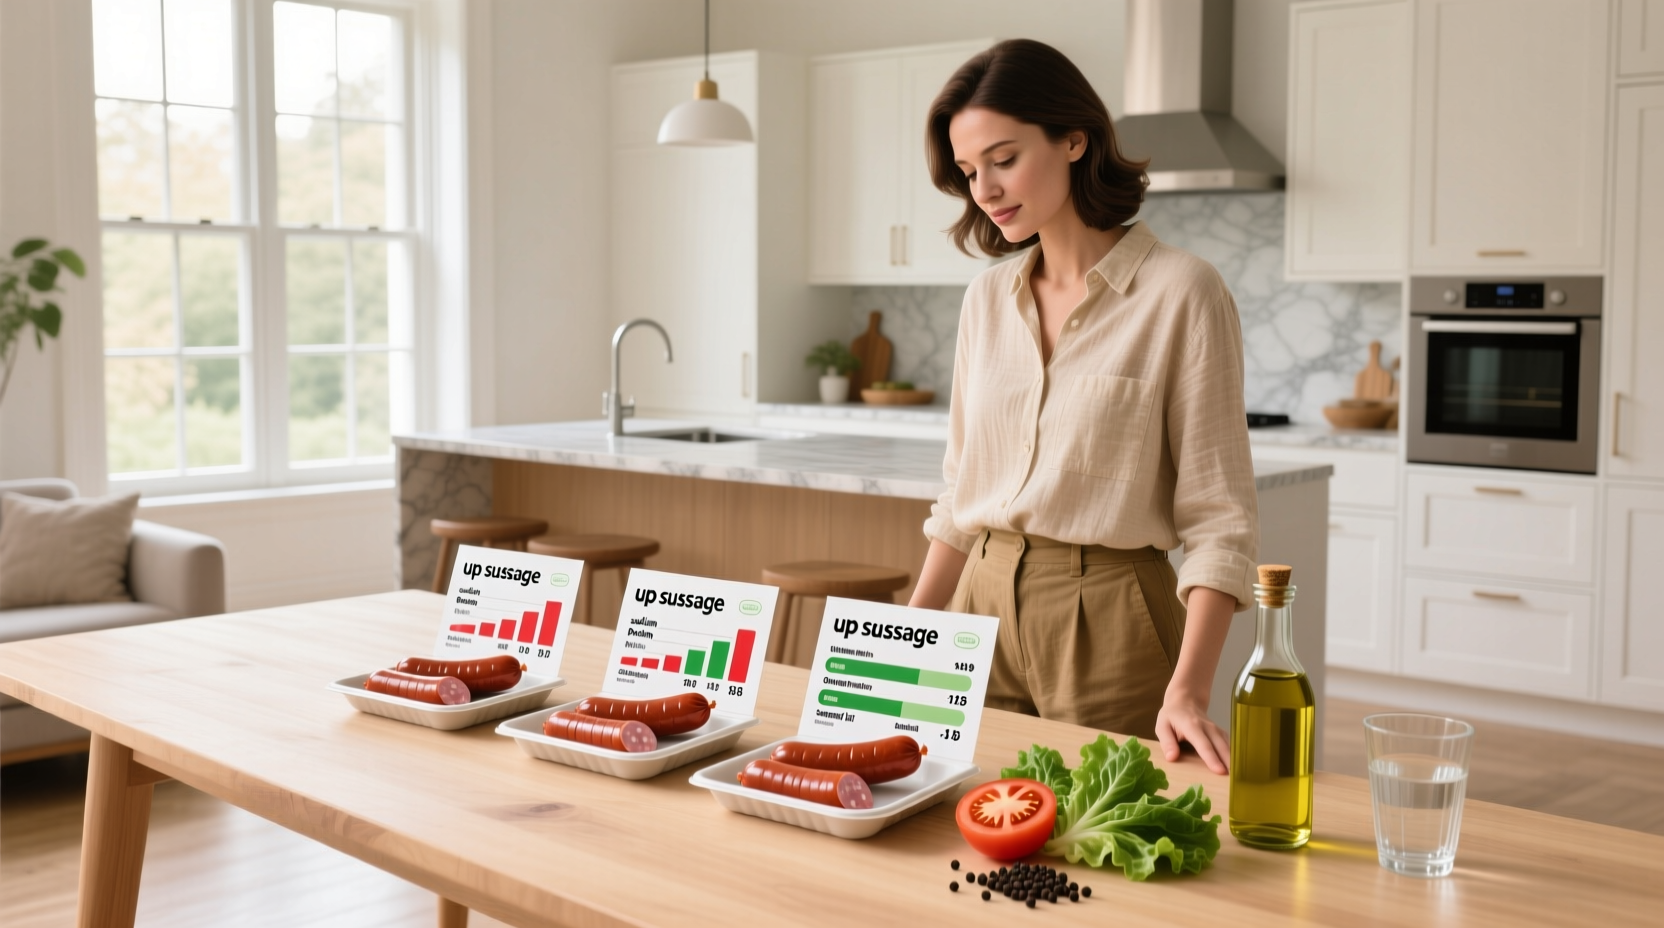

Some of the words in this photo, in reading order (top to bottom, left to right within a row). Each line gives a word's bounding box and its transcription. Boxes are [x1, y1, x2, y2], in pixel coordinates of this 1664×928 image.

[463, 562, 482, 580] up
[484, 565, 541, 586] sussage
[635, 588, 657, 607] up
[658, 591, 725, 615] sussage
[833, 618, 858, 639] up
[861, 621, 939, 649] sussage
